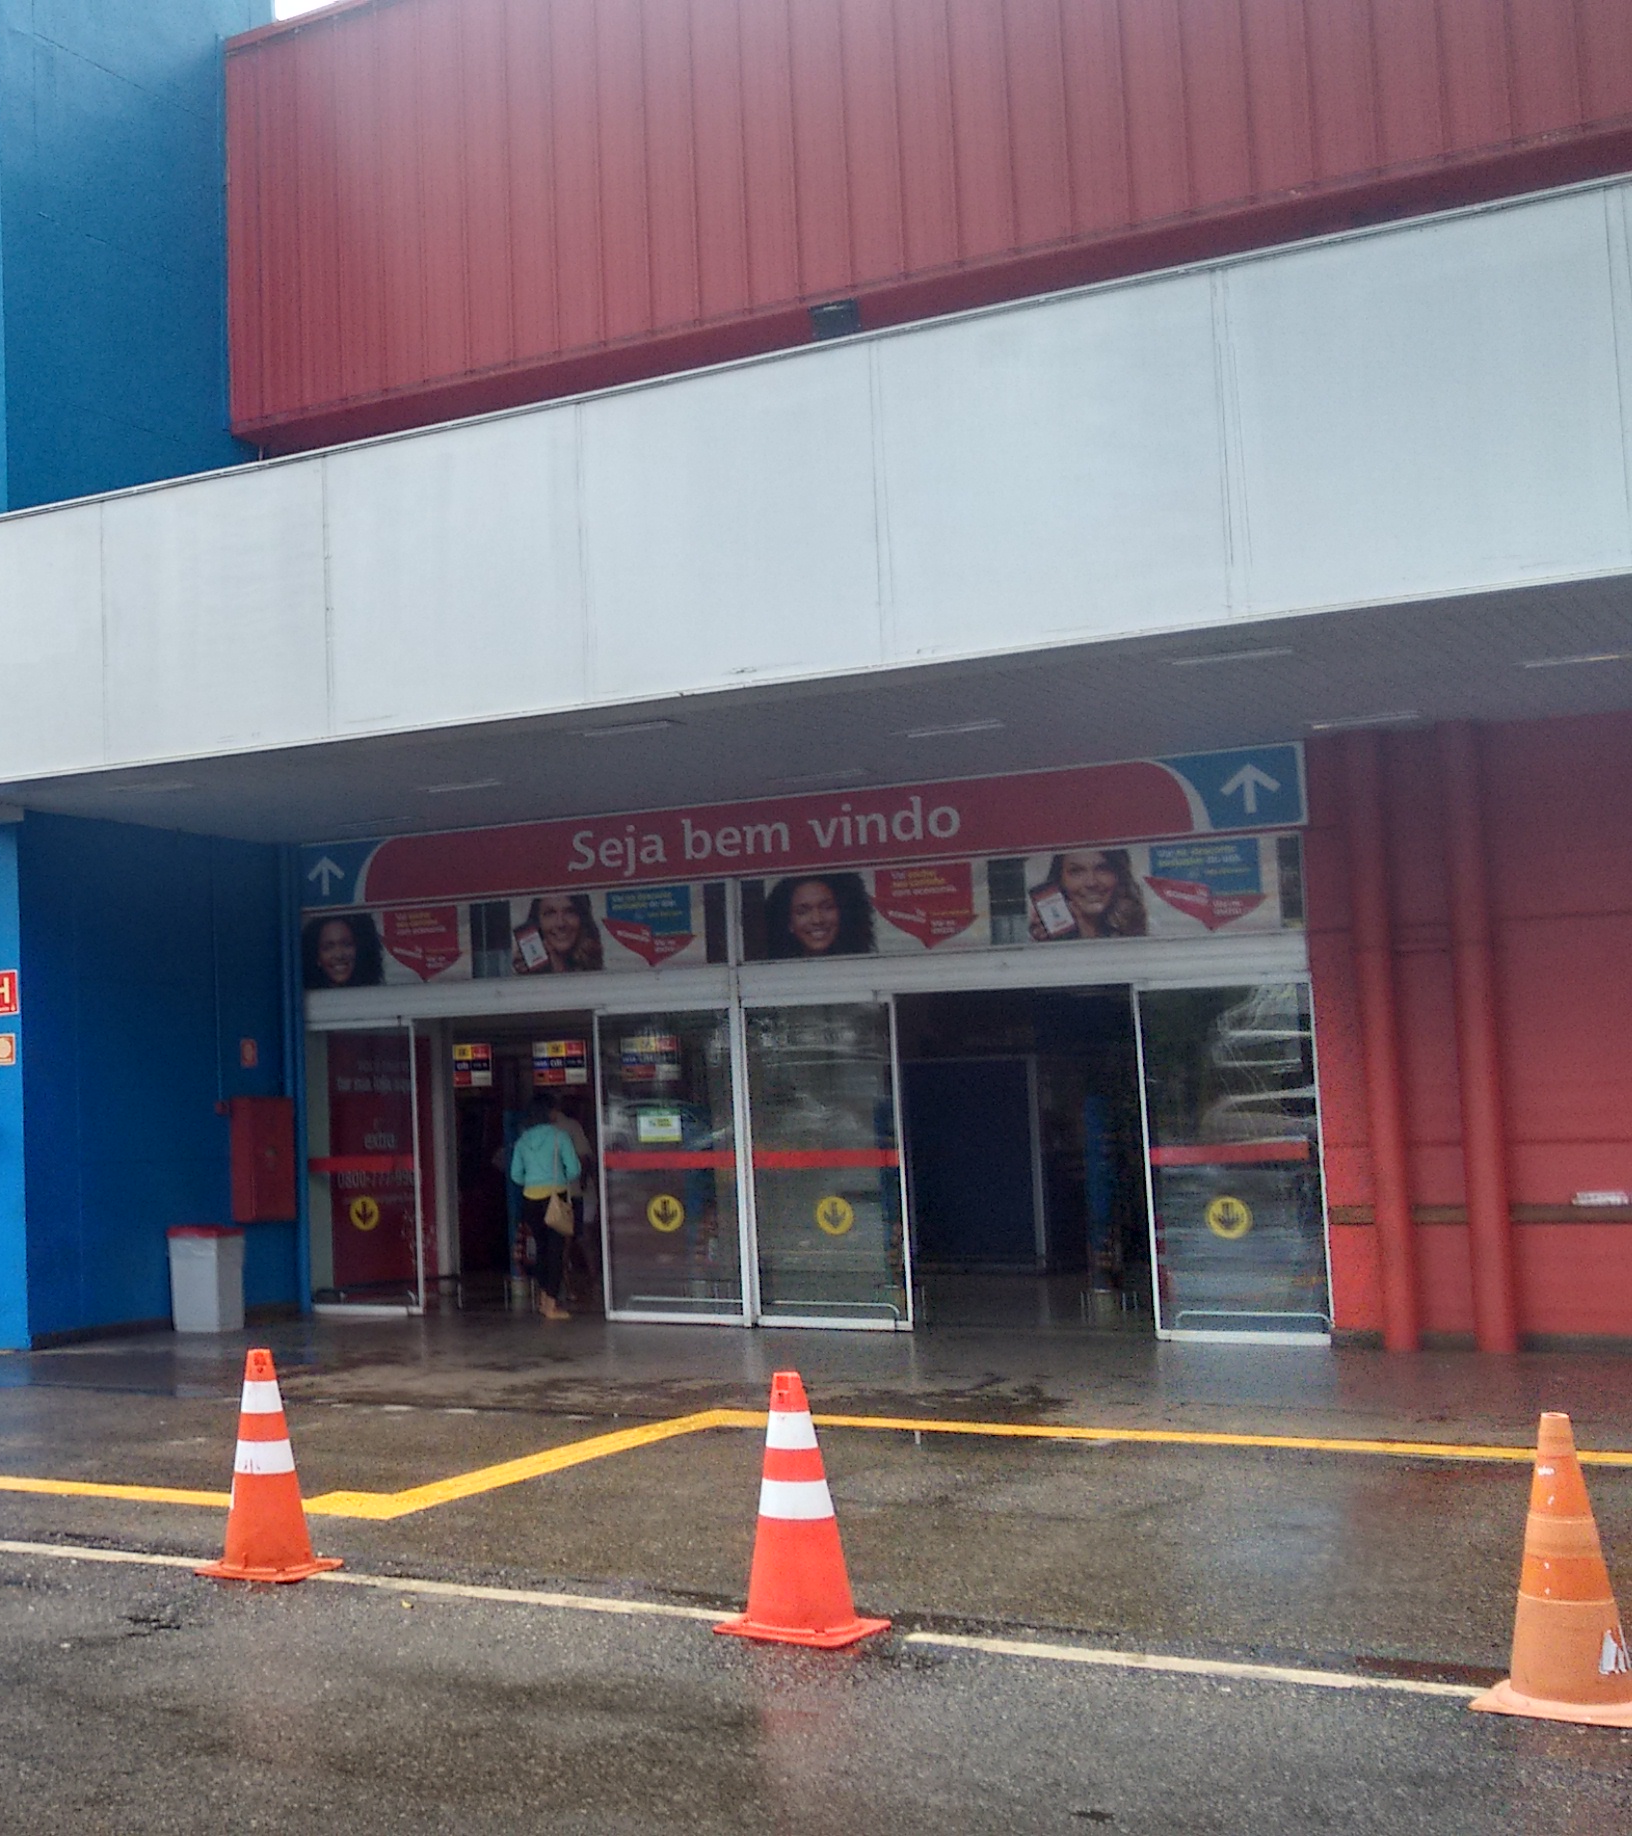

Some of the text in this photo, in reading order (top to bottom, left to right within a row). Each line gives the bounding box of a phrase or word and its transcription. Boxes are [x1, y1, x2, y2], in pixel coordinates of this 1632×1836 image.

[568, 795, 961, 876] Seja bem vindo
